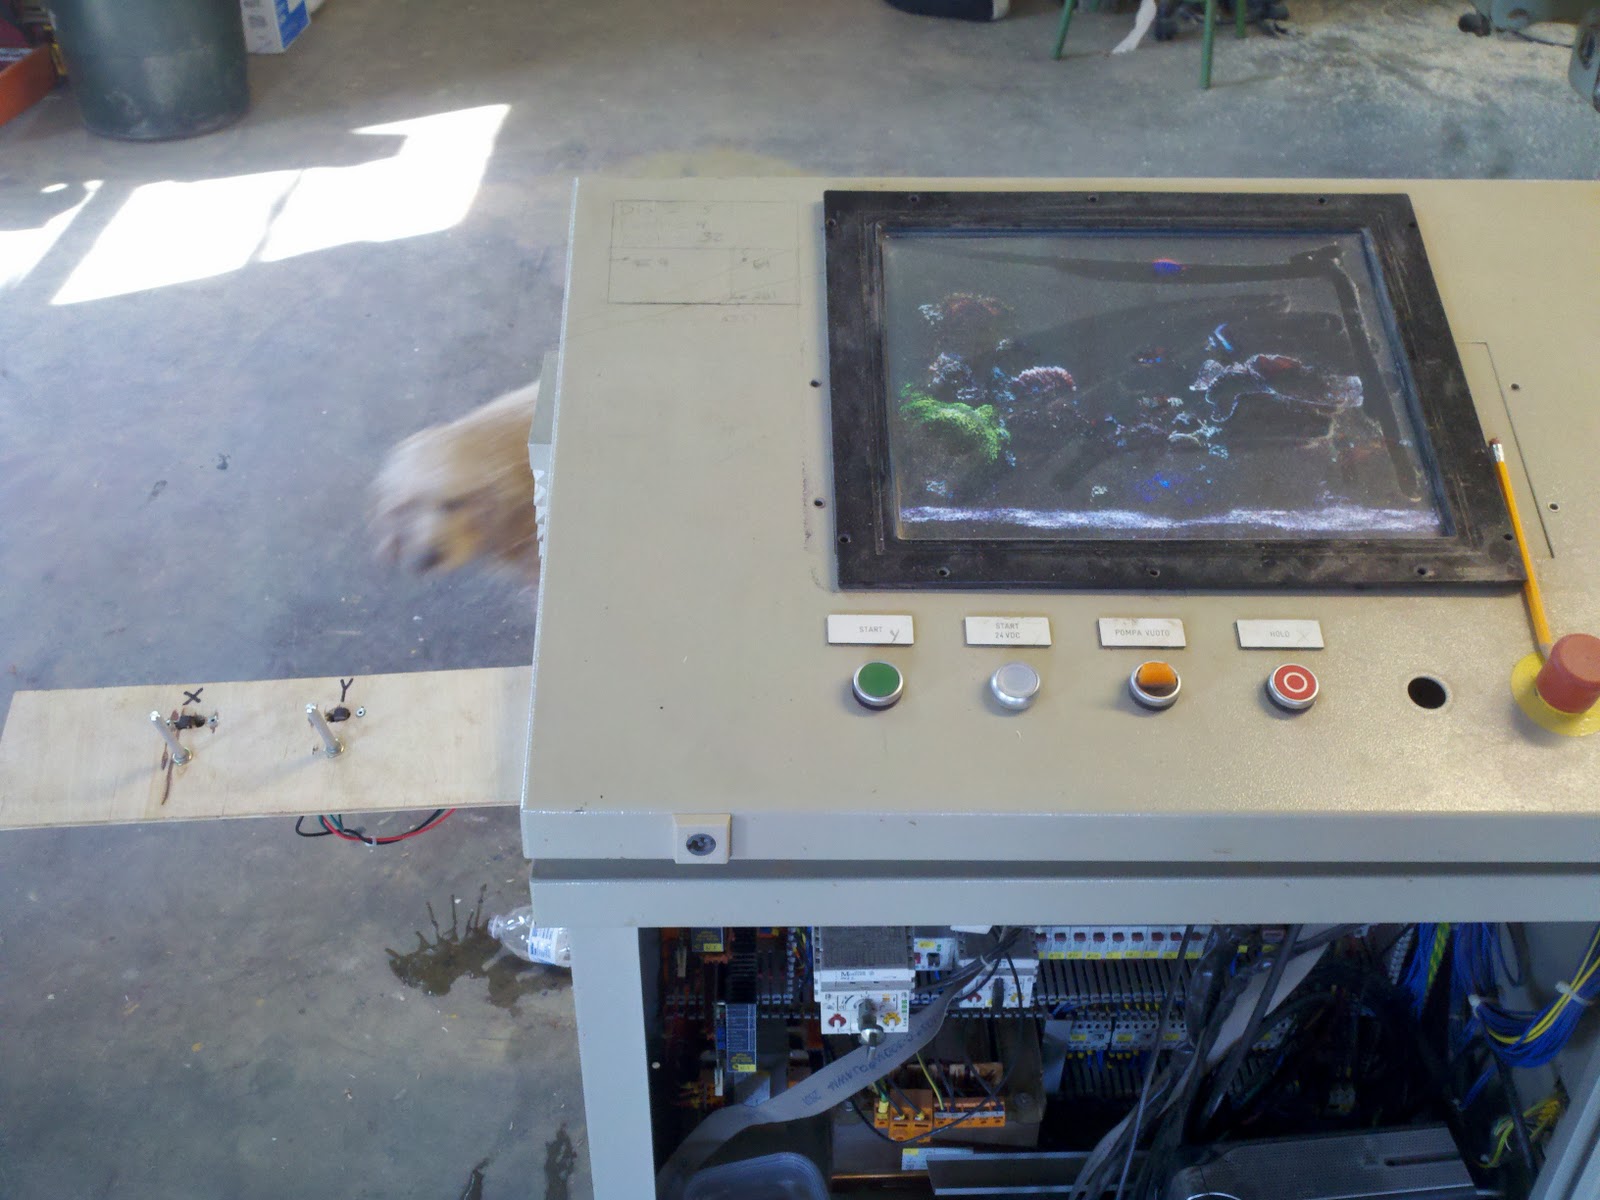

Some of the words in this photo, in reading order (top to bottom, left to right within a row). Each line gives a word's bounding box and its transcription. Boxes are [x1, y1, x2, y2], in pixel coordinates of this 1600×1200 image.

[859, 625, 882, 633] START
[995, 622, 1019, 630] START
[1115, 629, 1142, 637] POMPA
[1144, 629, 1170, 638] VUOTO
[340, 678, 354, 702] Y
[183, 687, 203, 705] X
